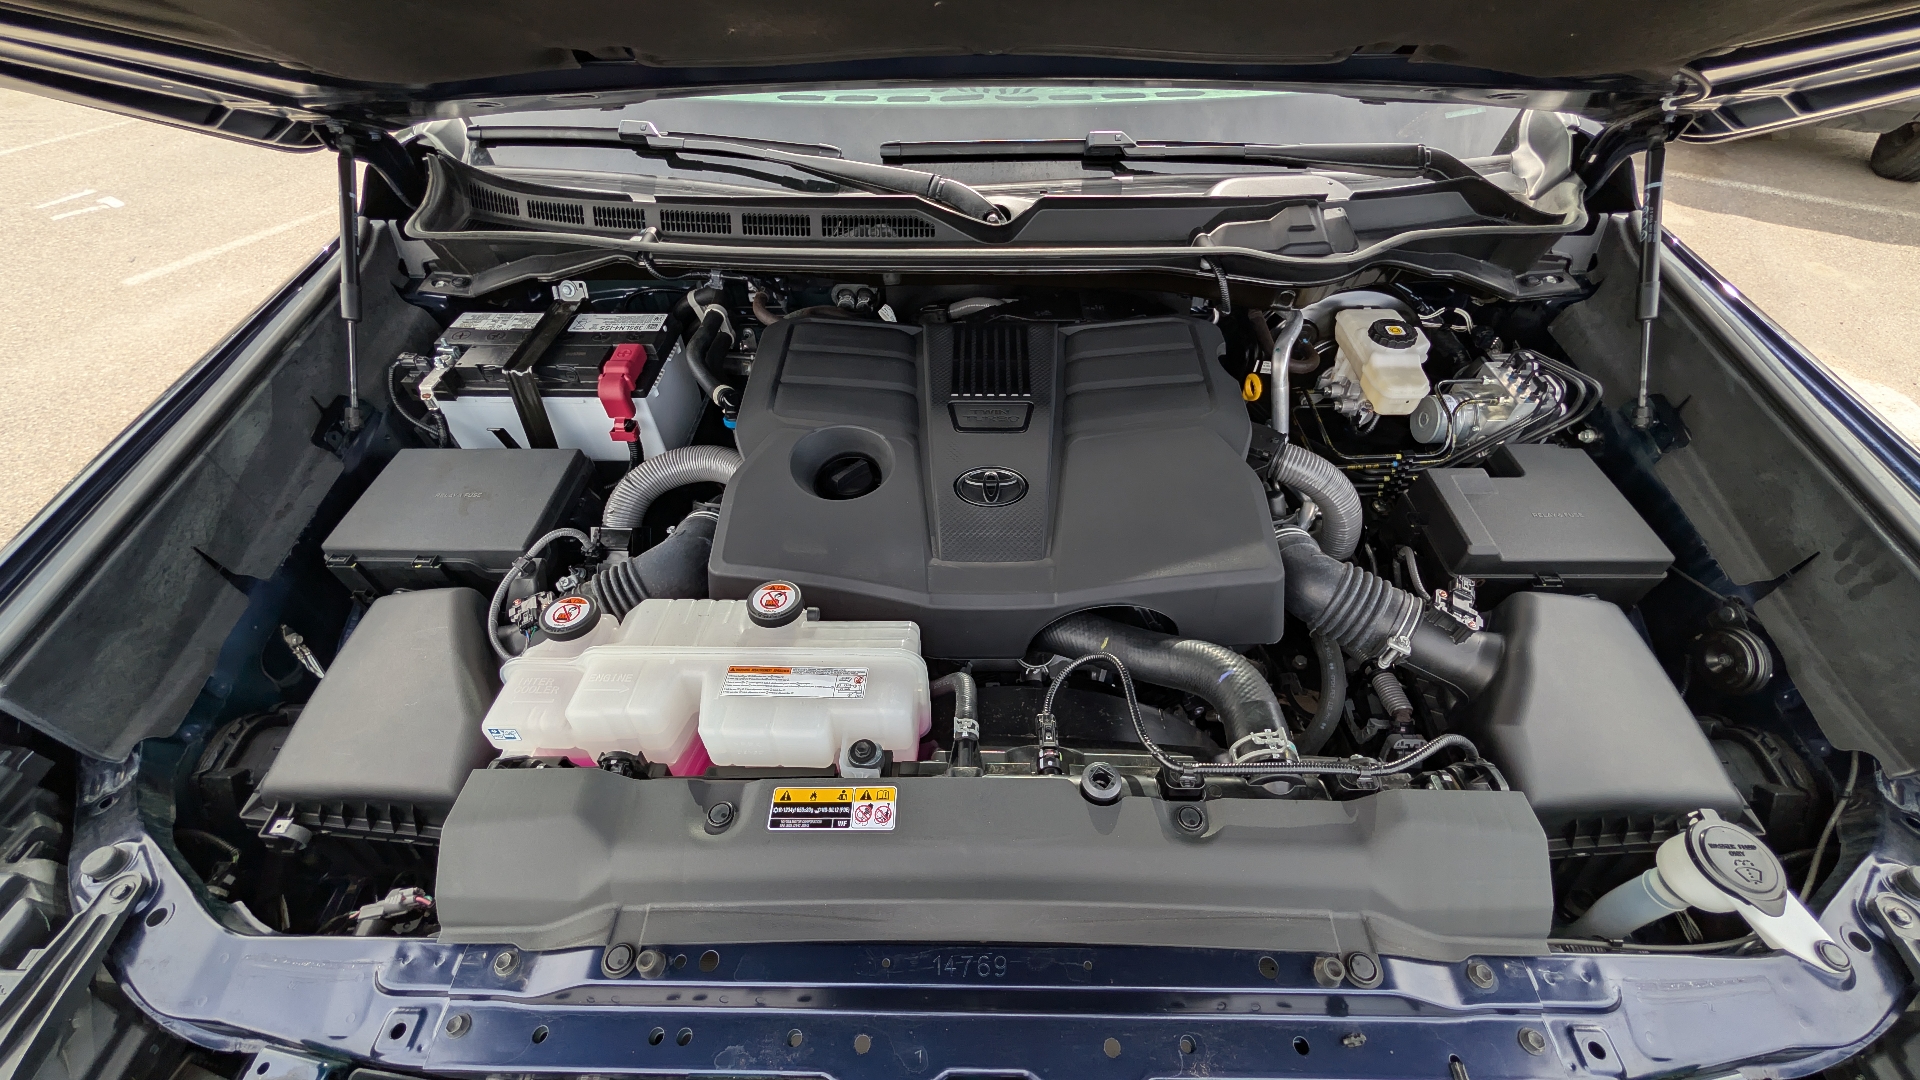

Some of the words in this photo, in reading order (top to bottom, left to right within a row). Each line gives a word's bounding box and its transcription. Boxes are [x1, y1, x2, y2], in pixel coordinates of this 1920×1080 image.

[518, 677, 555, 686] INTER
[588, 673, 634, 683] ENGINE
[513, 686, 560, 695] COOLER
[932, 955, 1007, 978] 14769
